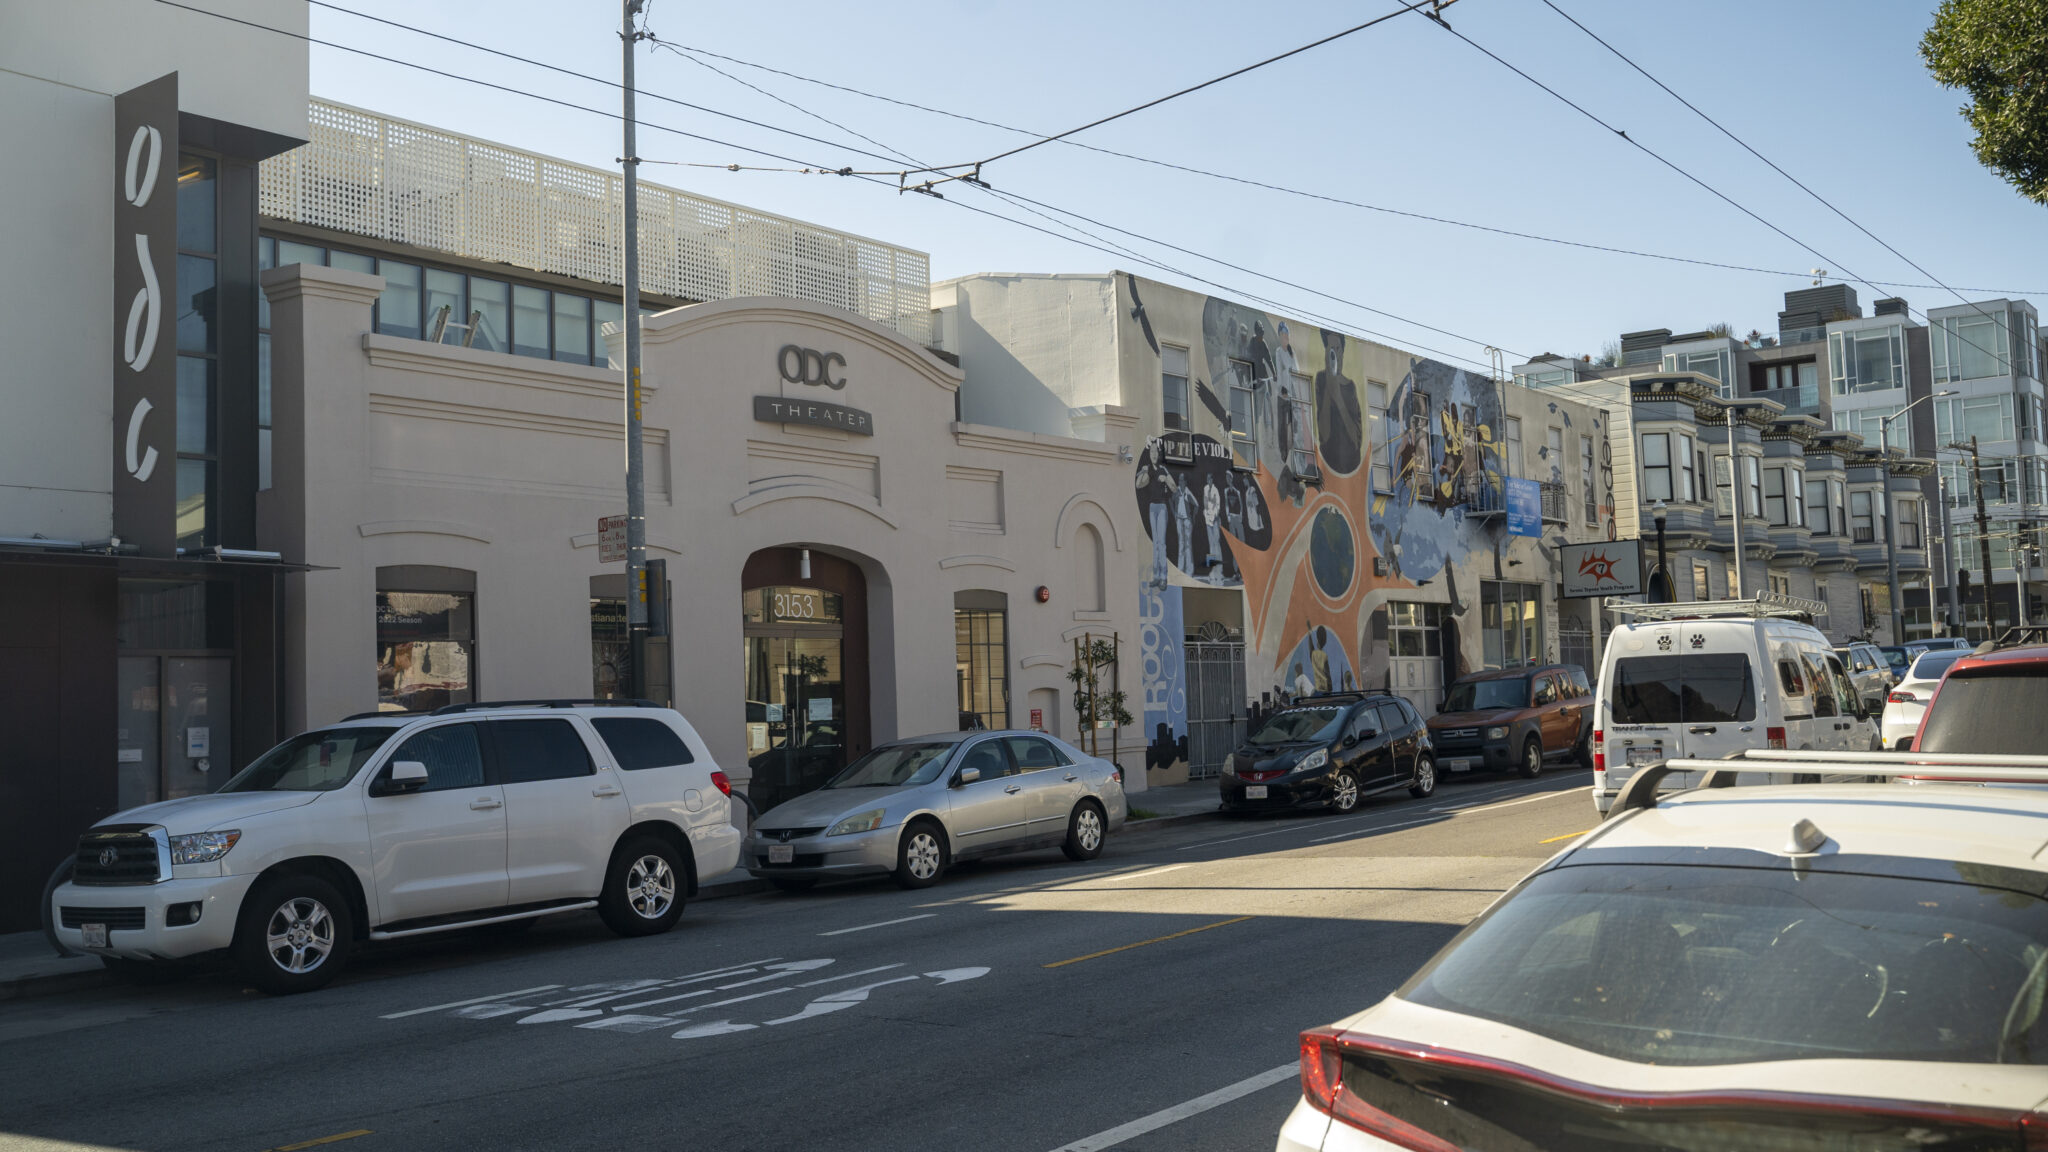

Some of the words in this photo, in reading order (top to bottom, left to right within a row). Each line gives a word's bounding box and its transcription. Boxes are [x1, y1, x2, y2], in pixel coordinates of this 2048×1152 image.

[778, 344, 847, 390] ODC
[771, 403, 866, 427] THEATER
[1598, 563, 1605, 574] 7
[774, 594, 814, 618] 3153
[398, 615, 423, 624] Season
[1279, 705, 1345, 715] HONDA
